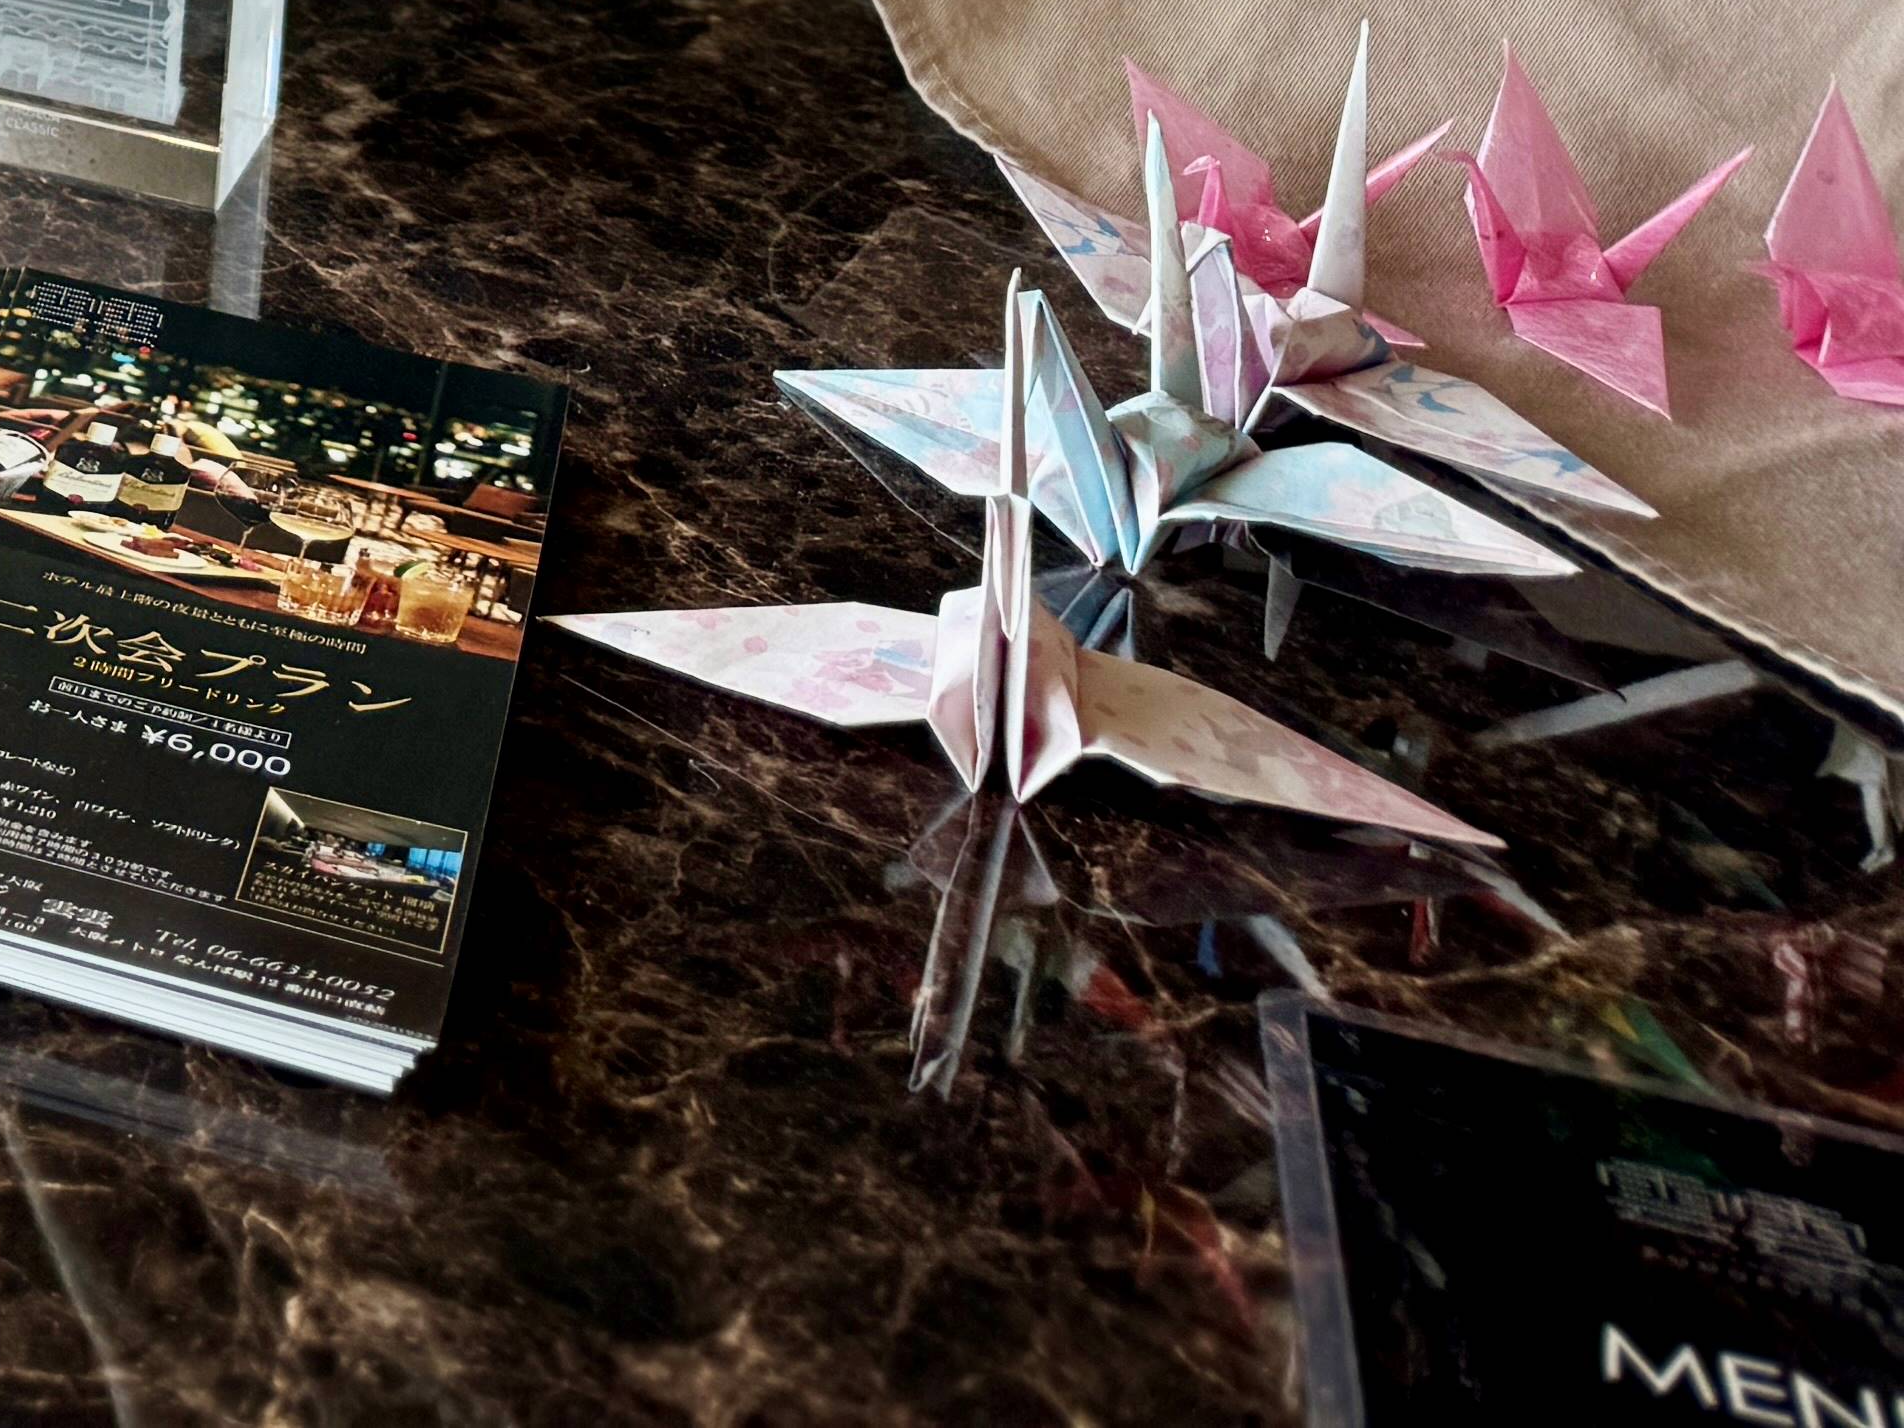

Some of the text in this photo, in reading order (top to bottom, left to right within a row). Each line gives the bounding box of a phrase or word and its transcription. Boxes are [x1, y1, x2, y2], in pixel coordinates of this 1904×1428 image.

[135, 722, 295, 782] ¥6,000
[204, 940, 398, 1004] 06-6633-0052
[1600, 1321, 1904, 1428] MEN
